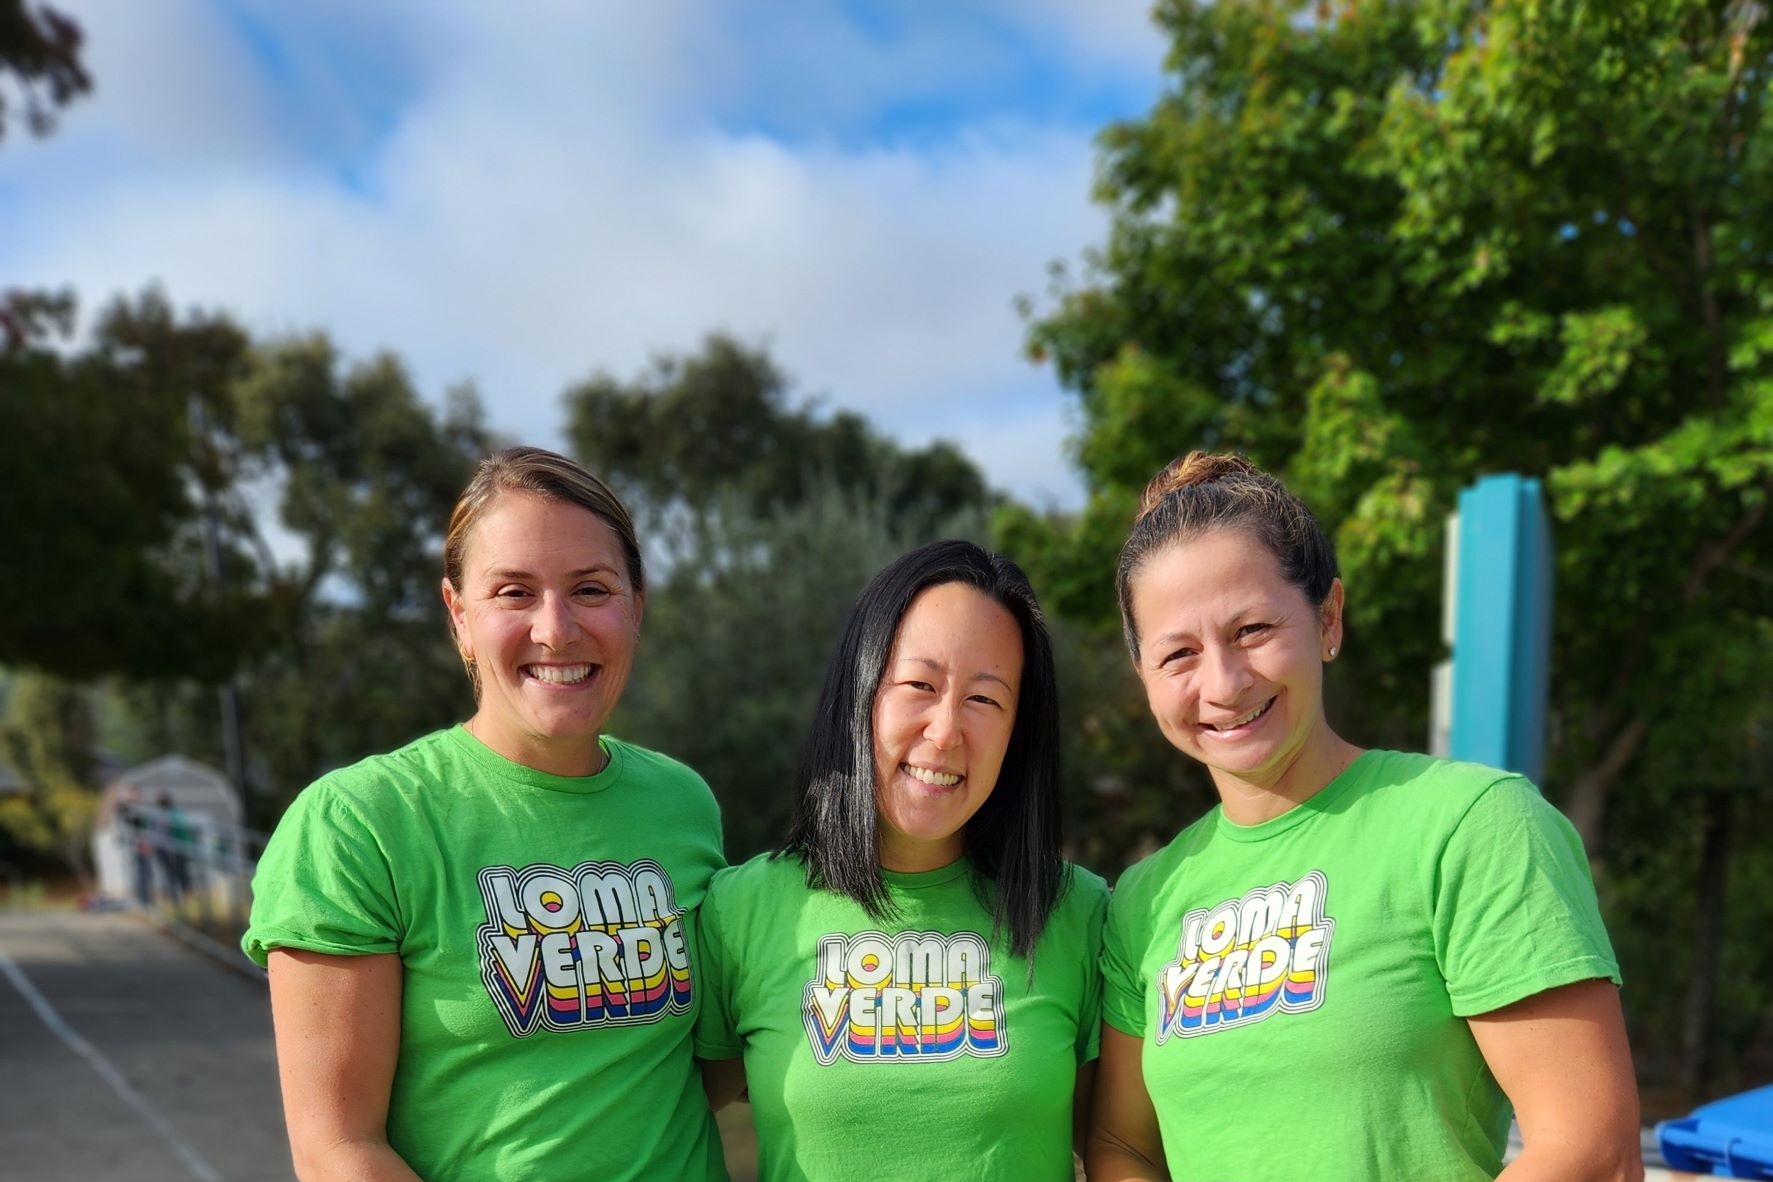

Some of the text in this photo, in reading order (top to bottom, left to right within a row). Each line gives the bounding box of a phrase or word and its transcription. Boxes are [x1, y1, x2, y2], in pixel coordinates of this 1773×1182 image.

[487, 867, 675, 935] LOMA
[1181, 878, 1320, 962] LOMA
[486, 916, 692, 1015] VERDE
[824, 937, 983, 988] LOMA
[1161, 927, 1327, 1018] VERDE
[811, 982, 998, 1043] VERDE
